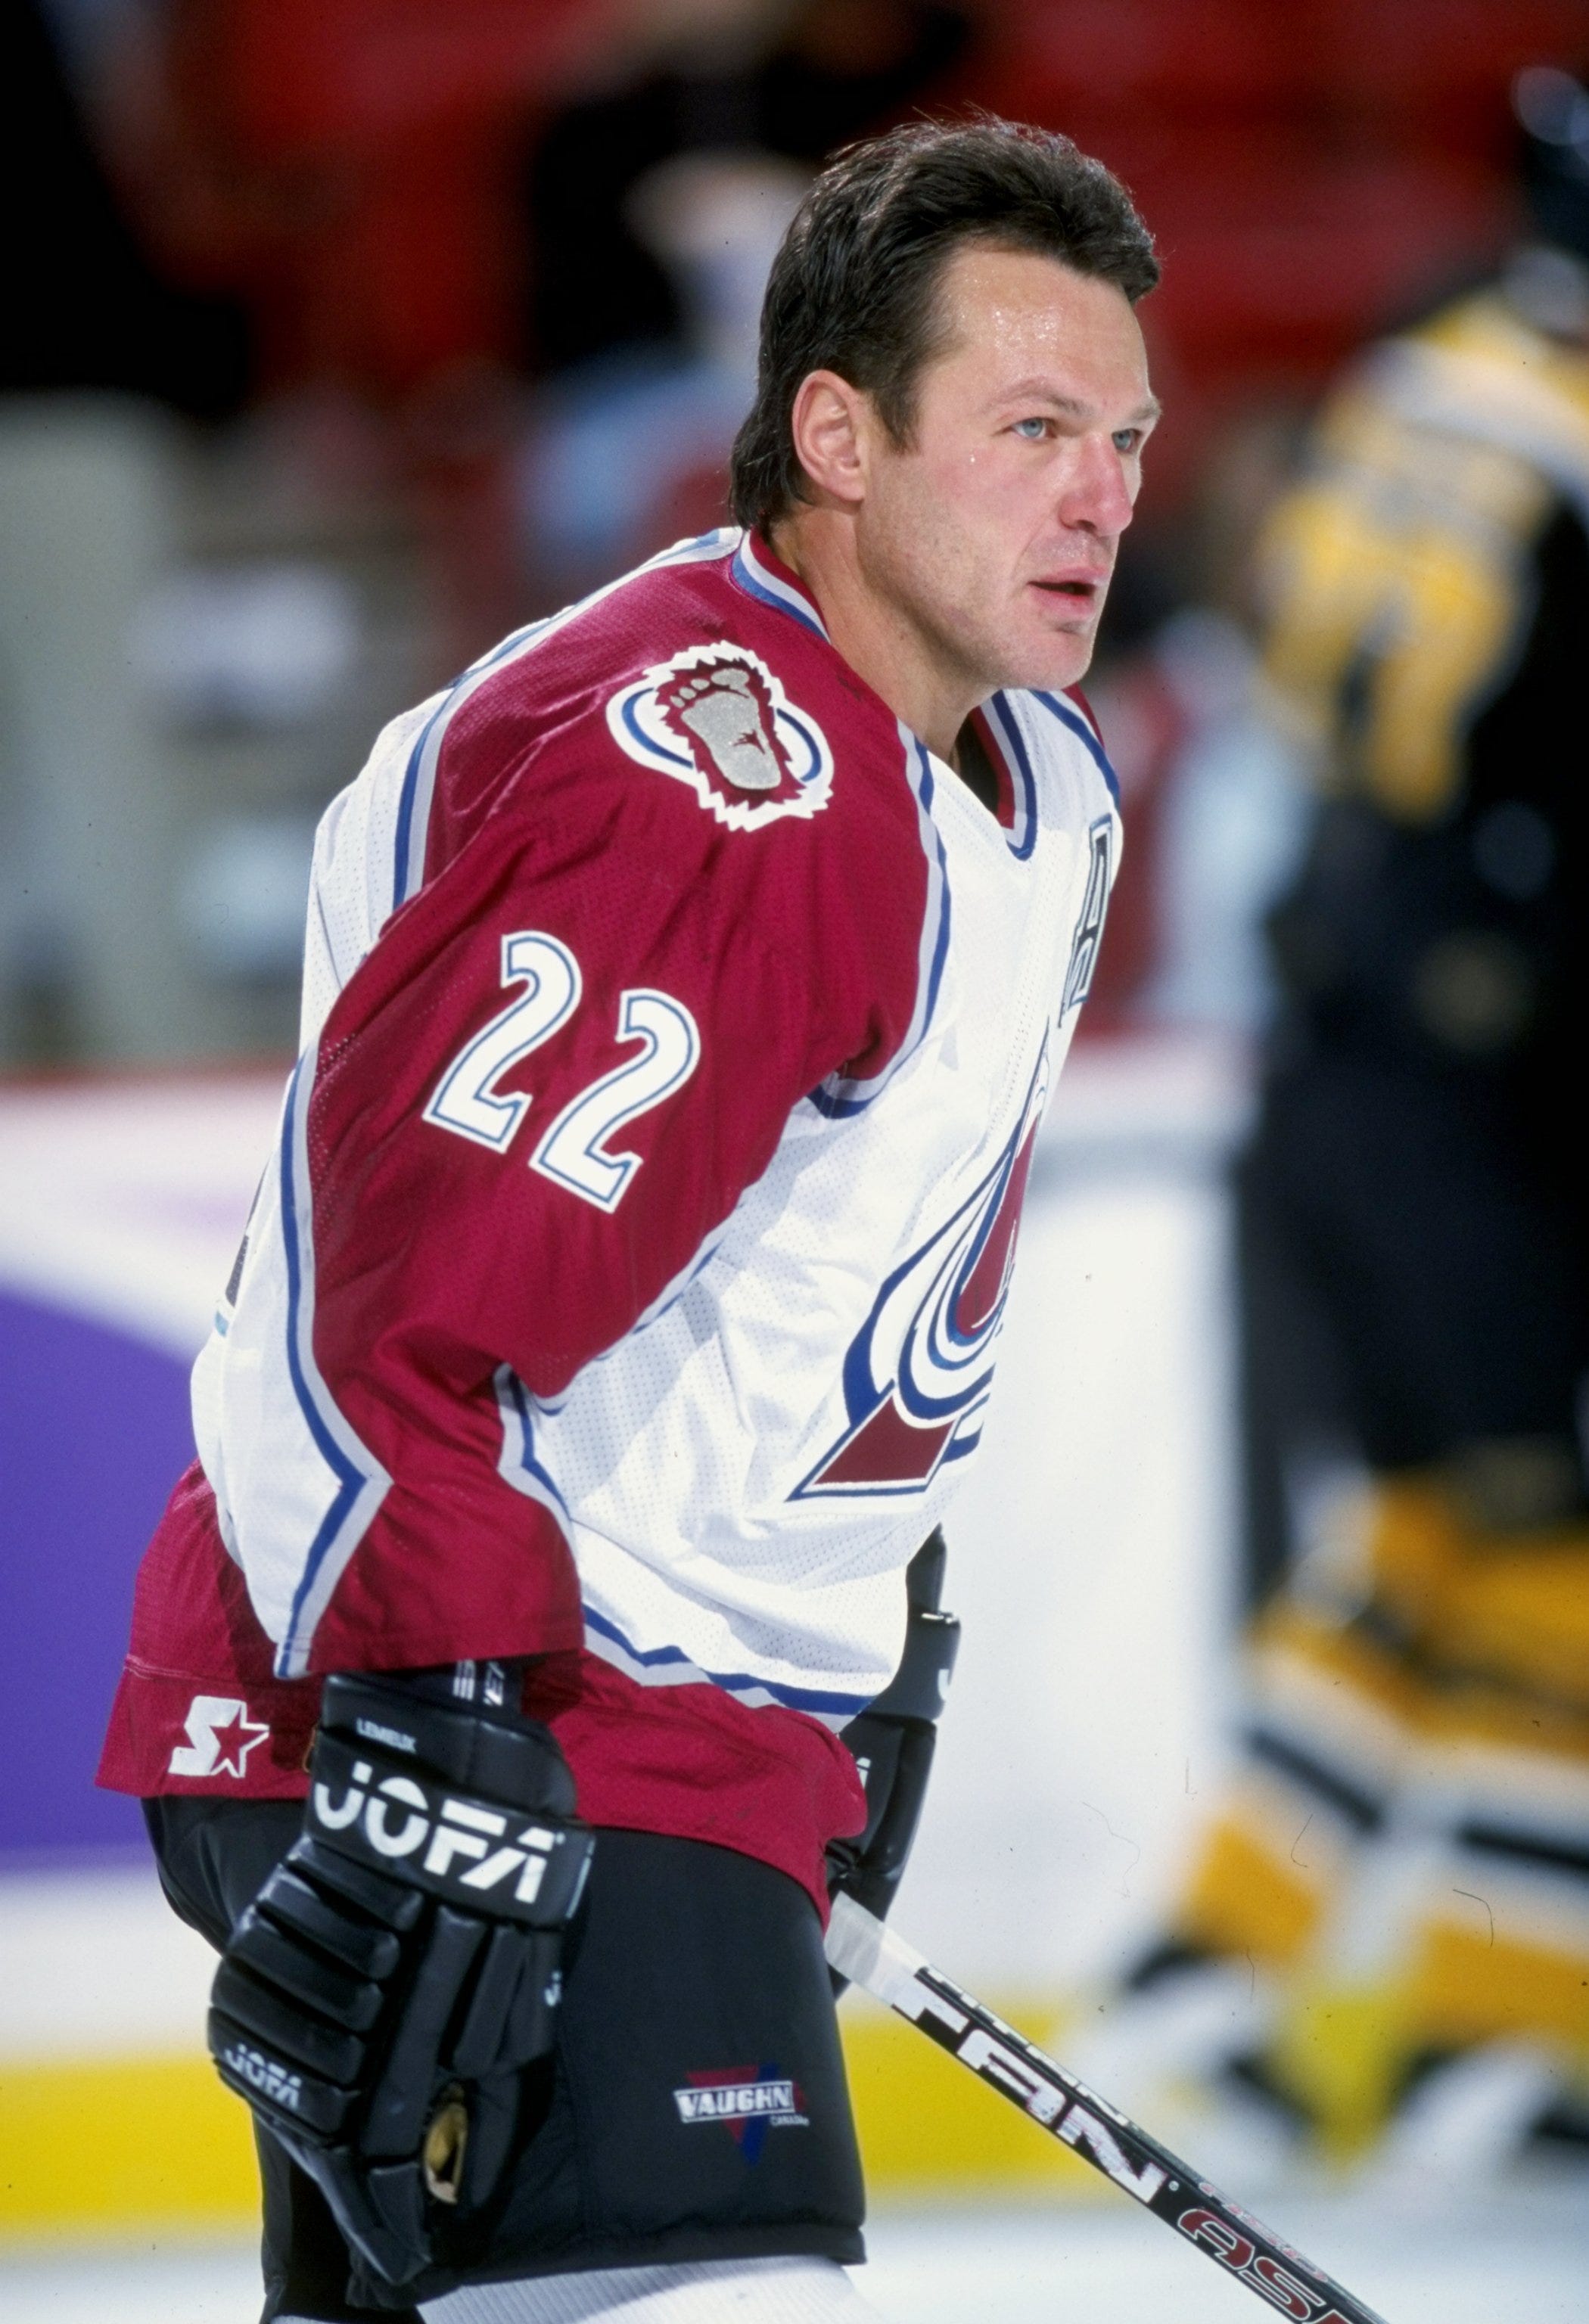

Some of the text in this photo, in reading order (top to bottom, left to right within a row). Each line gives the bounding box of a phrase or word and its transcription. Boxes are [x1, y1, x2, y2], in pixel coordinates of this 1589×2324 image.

[421, 930, 701, 1214] 22
[313, 1761, 549, 1903] JOFA
[224, 2043, 302, 2109] JOFA
[679, 2086, 791, 2118] VAUGHN
[1177, 2207, 1362, 2324] AS
